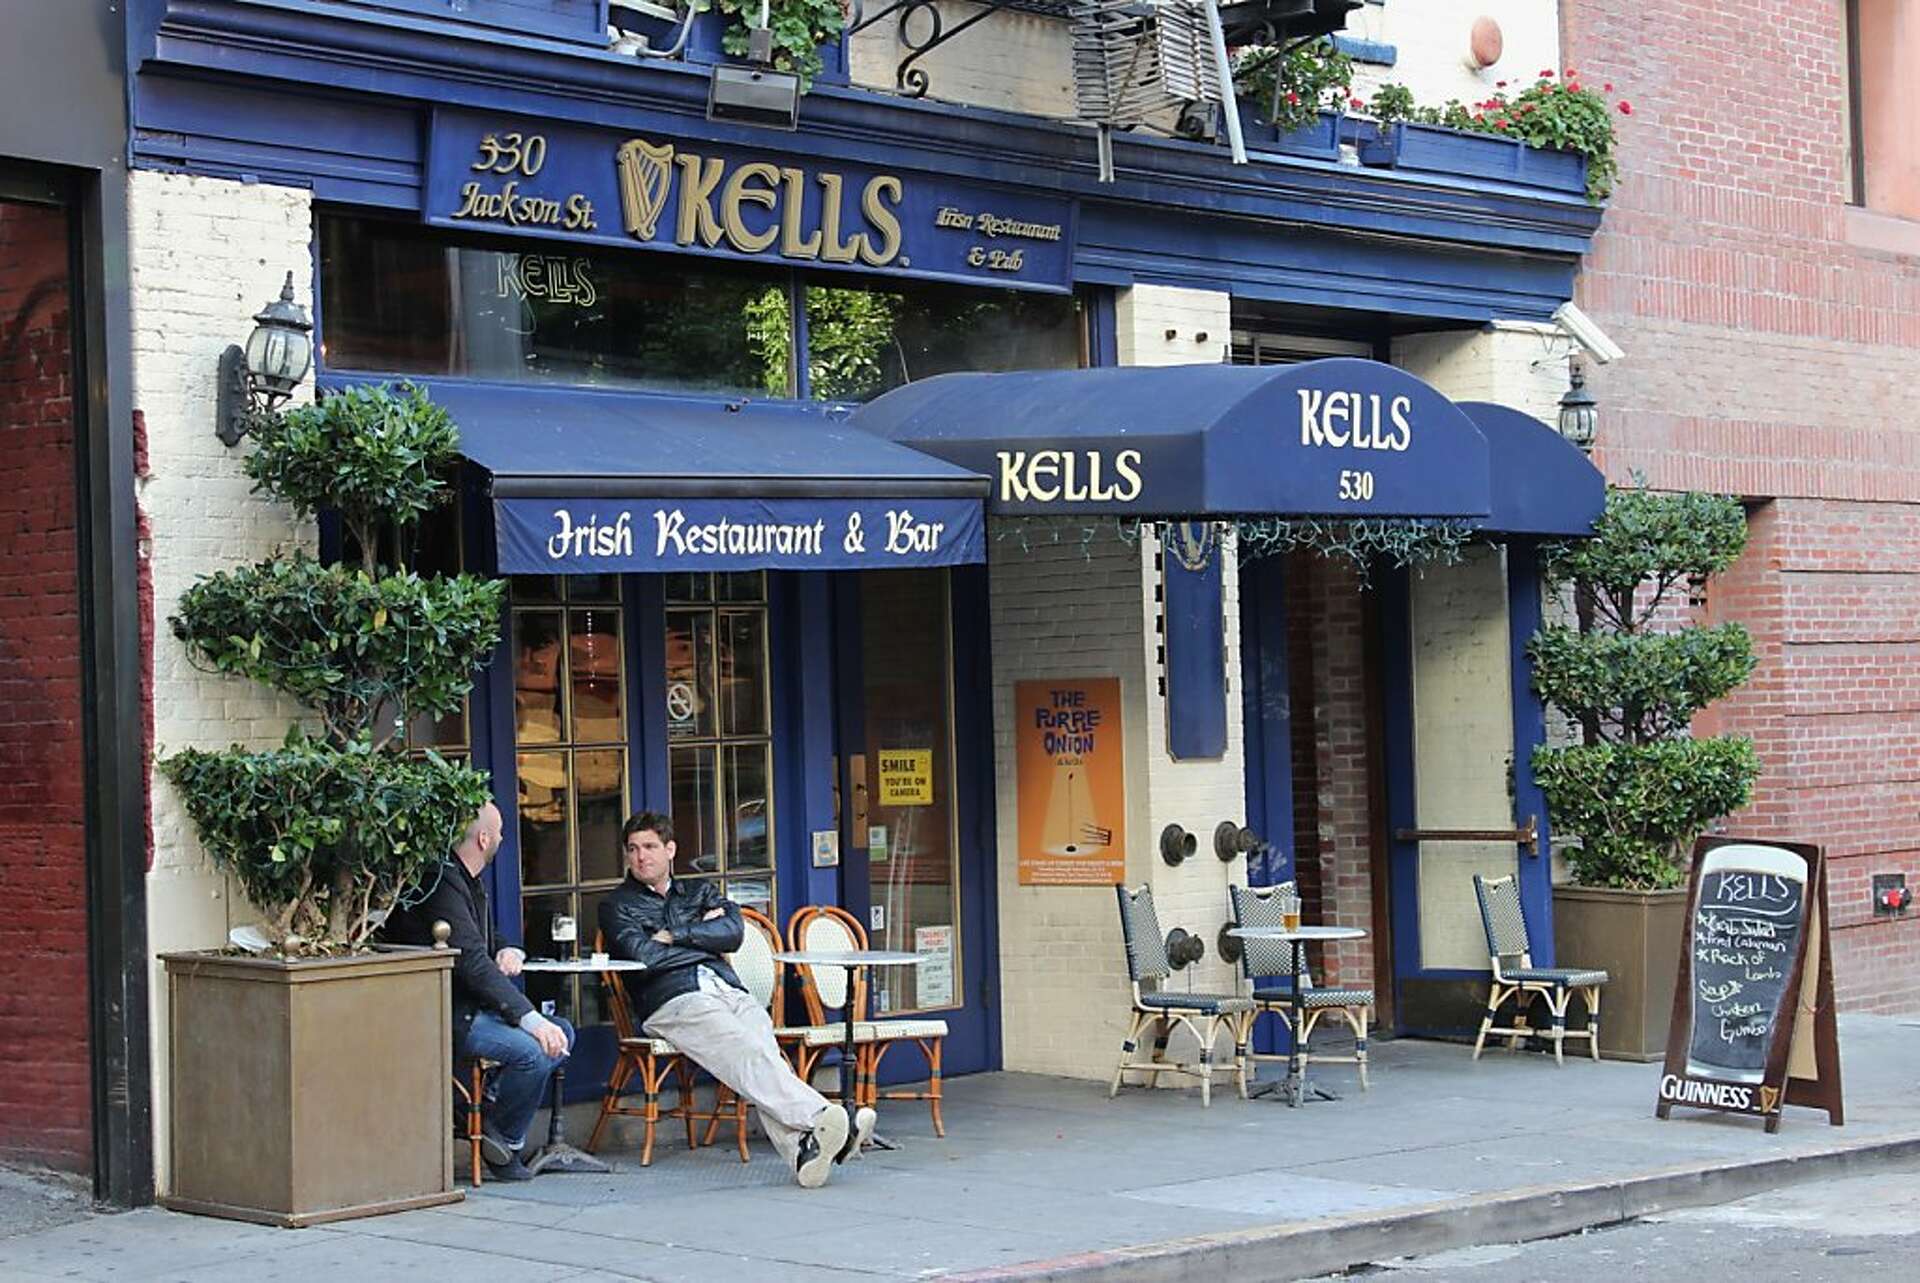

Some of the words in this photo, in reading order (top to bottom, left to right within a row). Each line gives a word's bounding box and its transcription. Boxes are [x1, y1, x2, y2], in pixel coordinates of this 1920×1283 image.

[471, 132, 546, 175] 530
[452, 181, 561, 225] Jackson
[563, 194, 597, 229] St.
[675, 153, 902, 267] KELLS
[936, 207, 973, 229] Irish
[976, 213, 1061, 240] Restaurant
[968, 247, 986, 266] &
[988, 250, 1024, 270] Pub
[495, 253, 595, 306] KELLS
[1297, 389, 1411, 451] KELLS
[997, 450, 1142, 501] KELLS
[1339, 470, 1373, 500] 530
[548, 509, 632, 558] Irish
[653, 509, 824, 557] Restaurant
[843, 512, 865, 554] &
[885, 510, 943, 555] Bar
[1050, 690, 1085, 708] THE
[1045, 732, 1094, 755] ONION
[882, 759, 916, 772] SMILE
[1717, 870, 1789, 902] KELLS
[1711, 949, 1749, 965] Rack
[1751, 950, 1766, 965] of
[1720, 1018, 1767, 1043] Gumbo
[1660, 1074, 1752, 1109] GUINNESS
